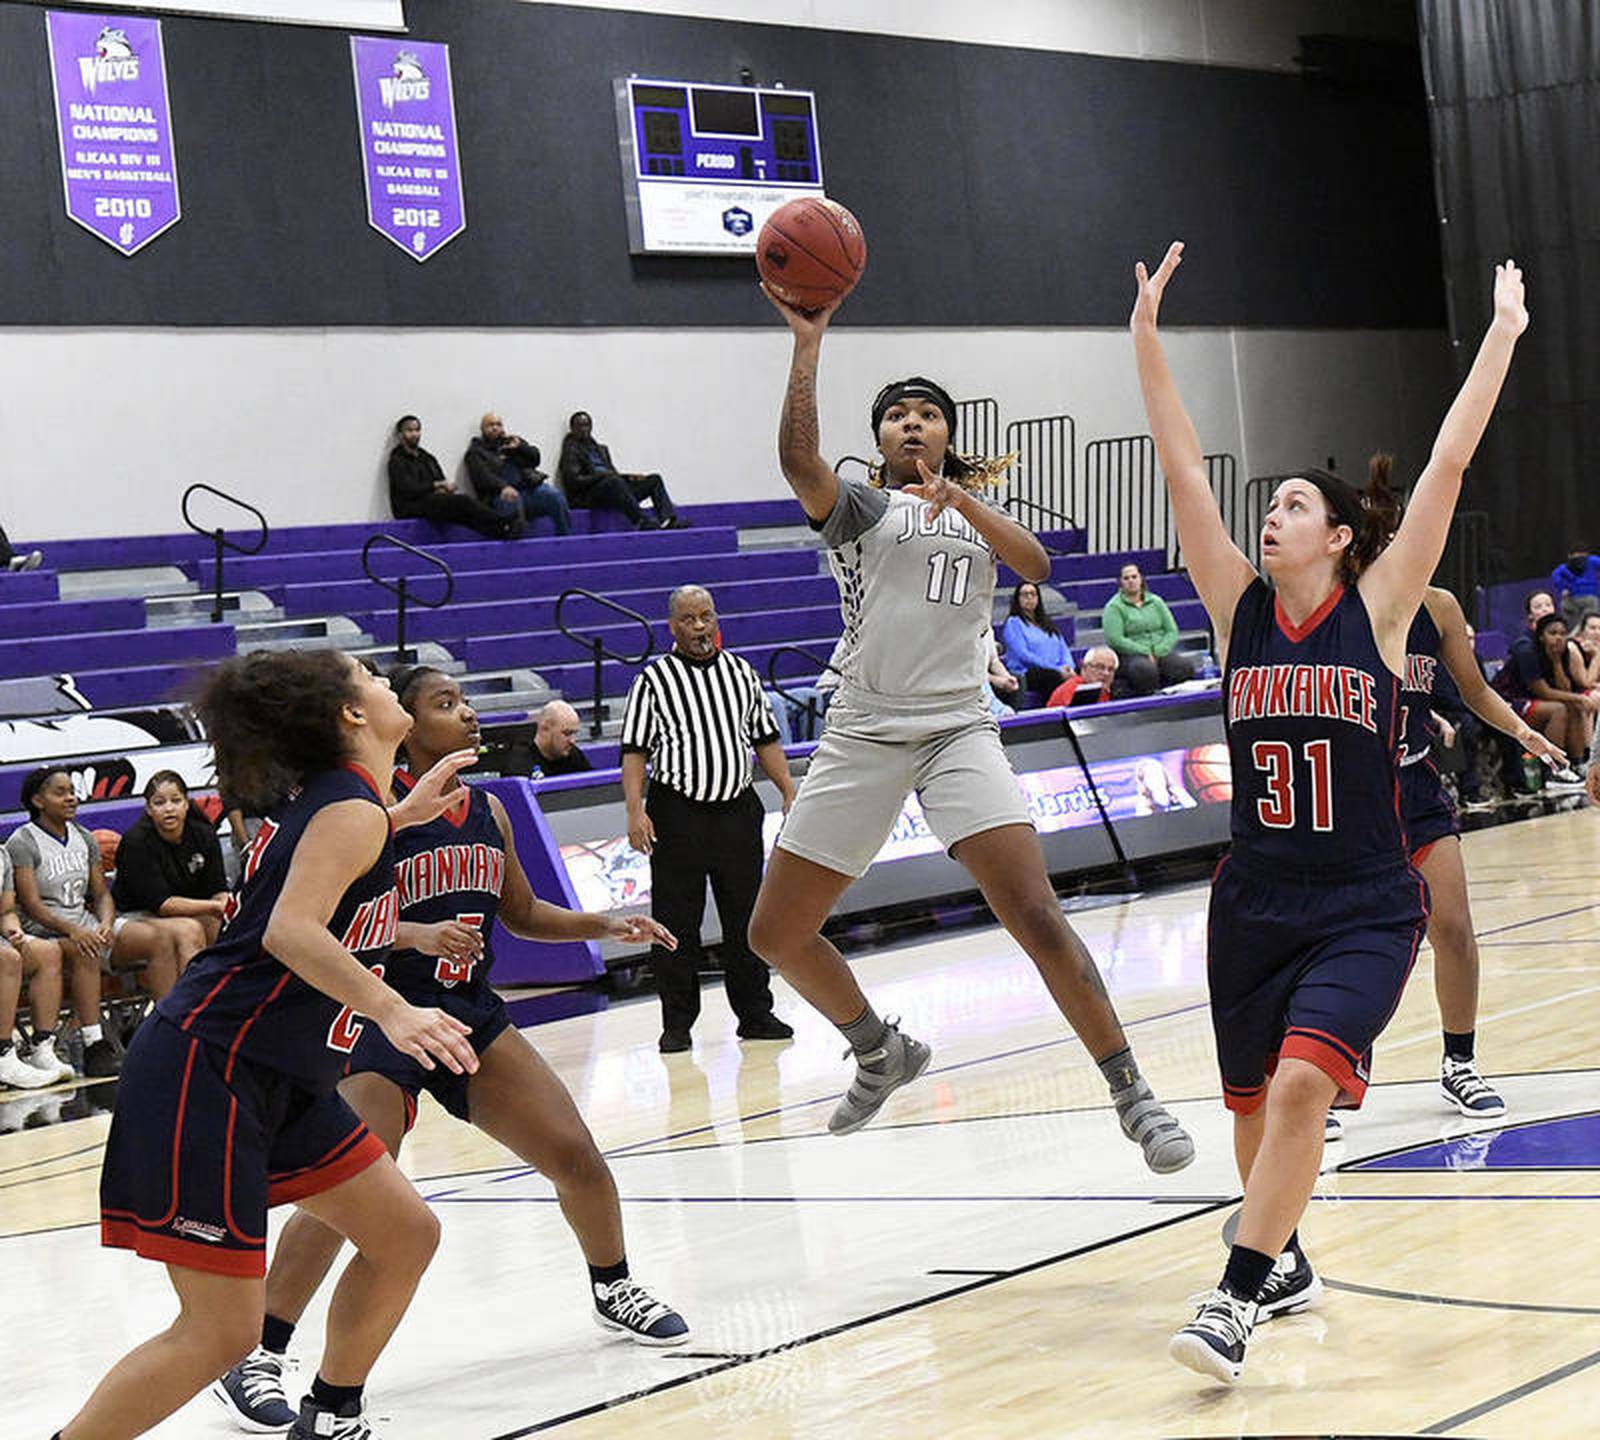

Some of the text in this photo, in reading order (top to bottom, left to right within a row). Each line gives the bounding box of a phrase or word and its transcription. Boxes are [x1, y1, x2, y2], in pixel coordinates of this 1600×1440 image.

[69, 103, 157, 124] NATIONAL
[72, 125, 159, 143] CHAMPIONS
[371, 121, 445, 141] NATIONAL
[373, 140, 447, 158] CHAMPIONS
[95, 197, 152, 218] 2010
[392, 207, 441, 228] 2012
[927, 550, 973, 606] 11
[1229, 664, 1377, 734] ANKAKEE
[1252, 739, 1334, 832] 31
